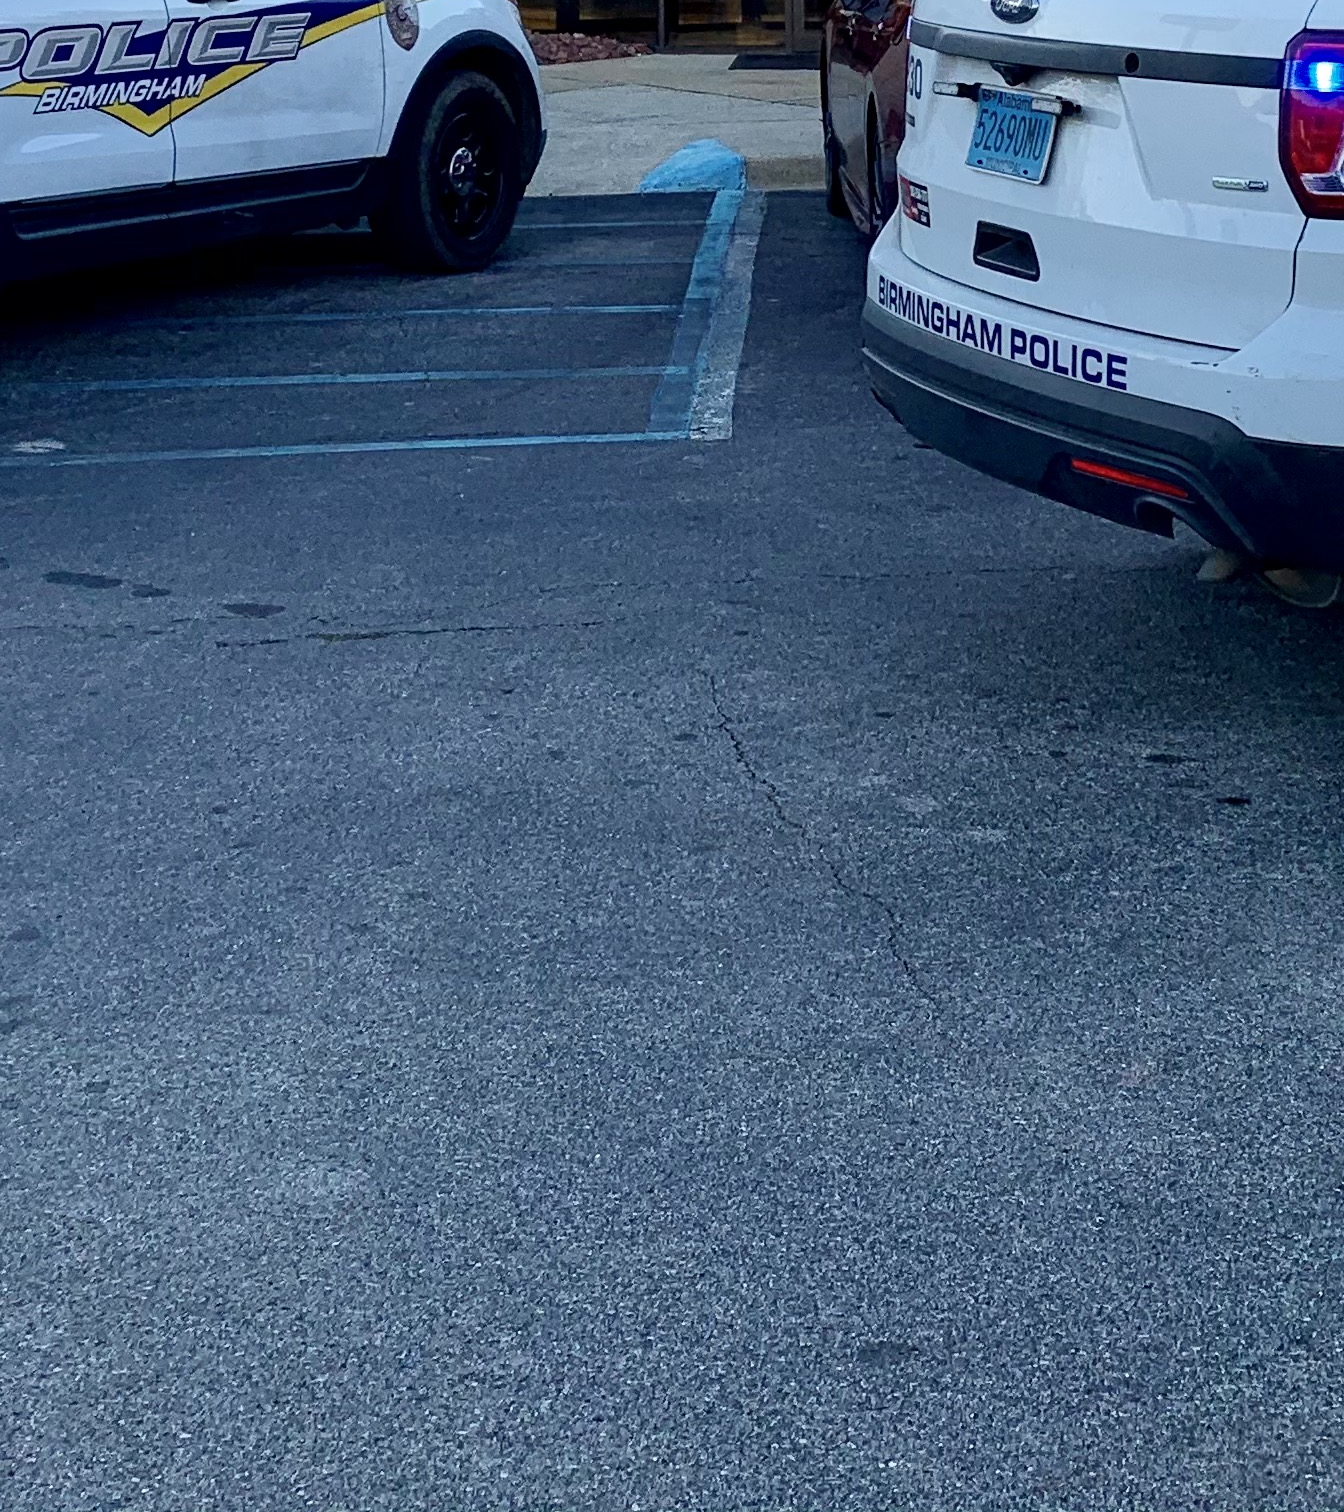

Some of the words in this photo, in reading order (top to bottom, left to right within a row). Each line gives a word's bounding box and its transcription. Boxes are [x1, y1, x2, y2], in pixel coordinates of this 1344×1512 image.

[33, 73, 206, 115] BIRMINGHAM
[996, 91, 1033, 112] Alabam
[878, 274, 1003, 356] BIRMINGHAM
[1010, 327, 1129, 392] POLICE
